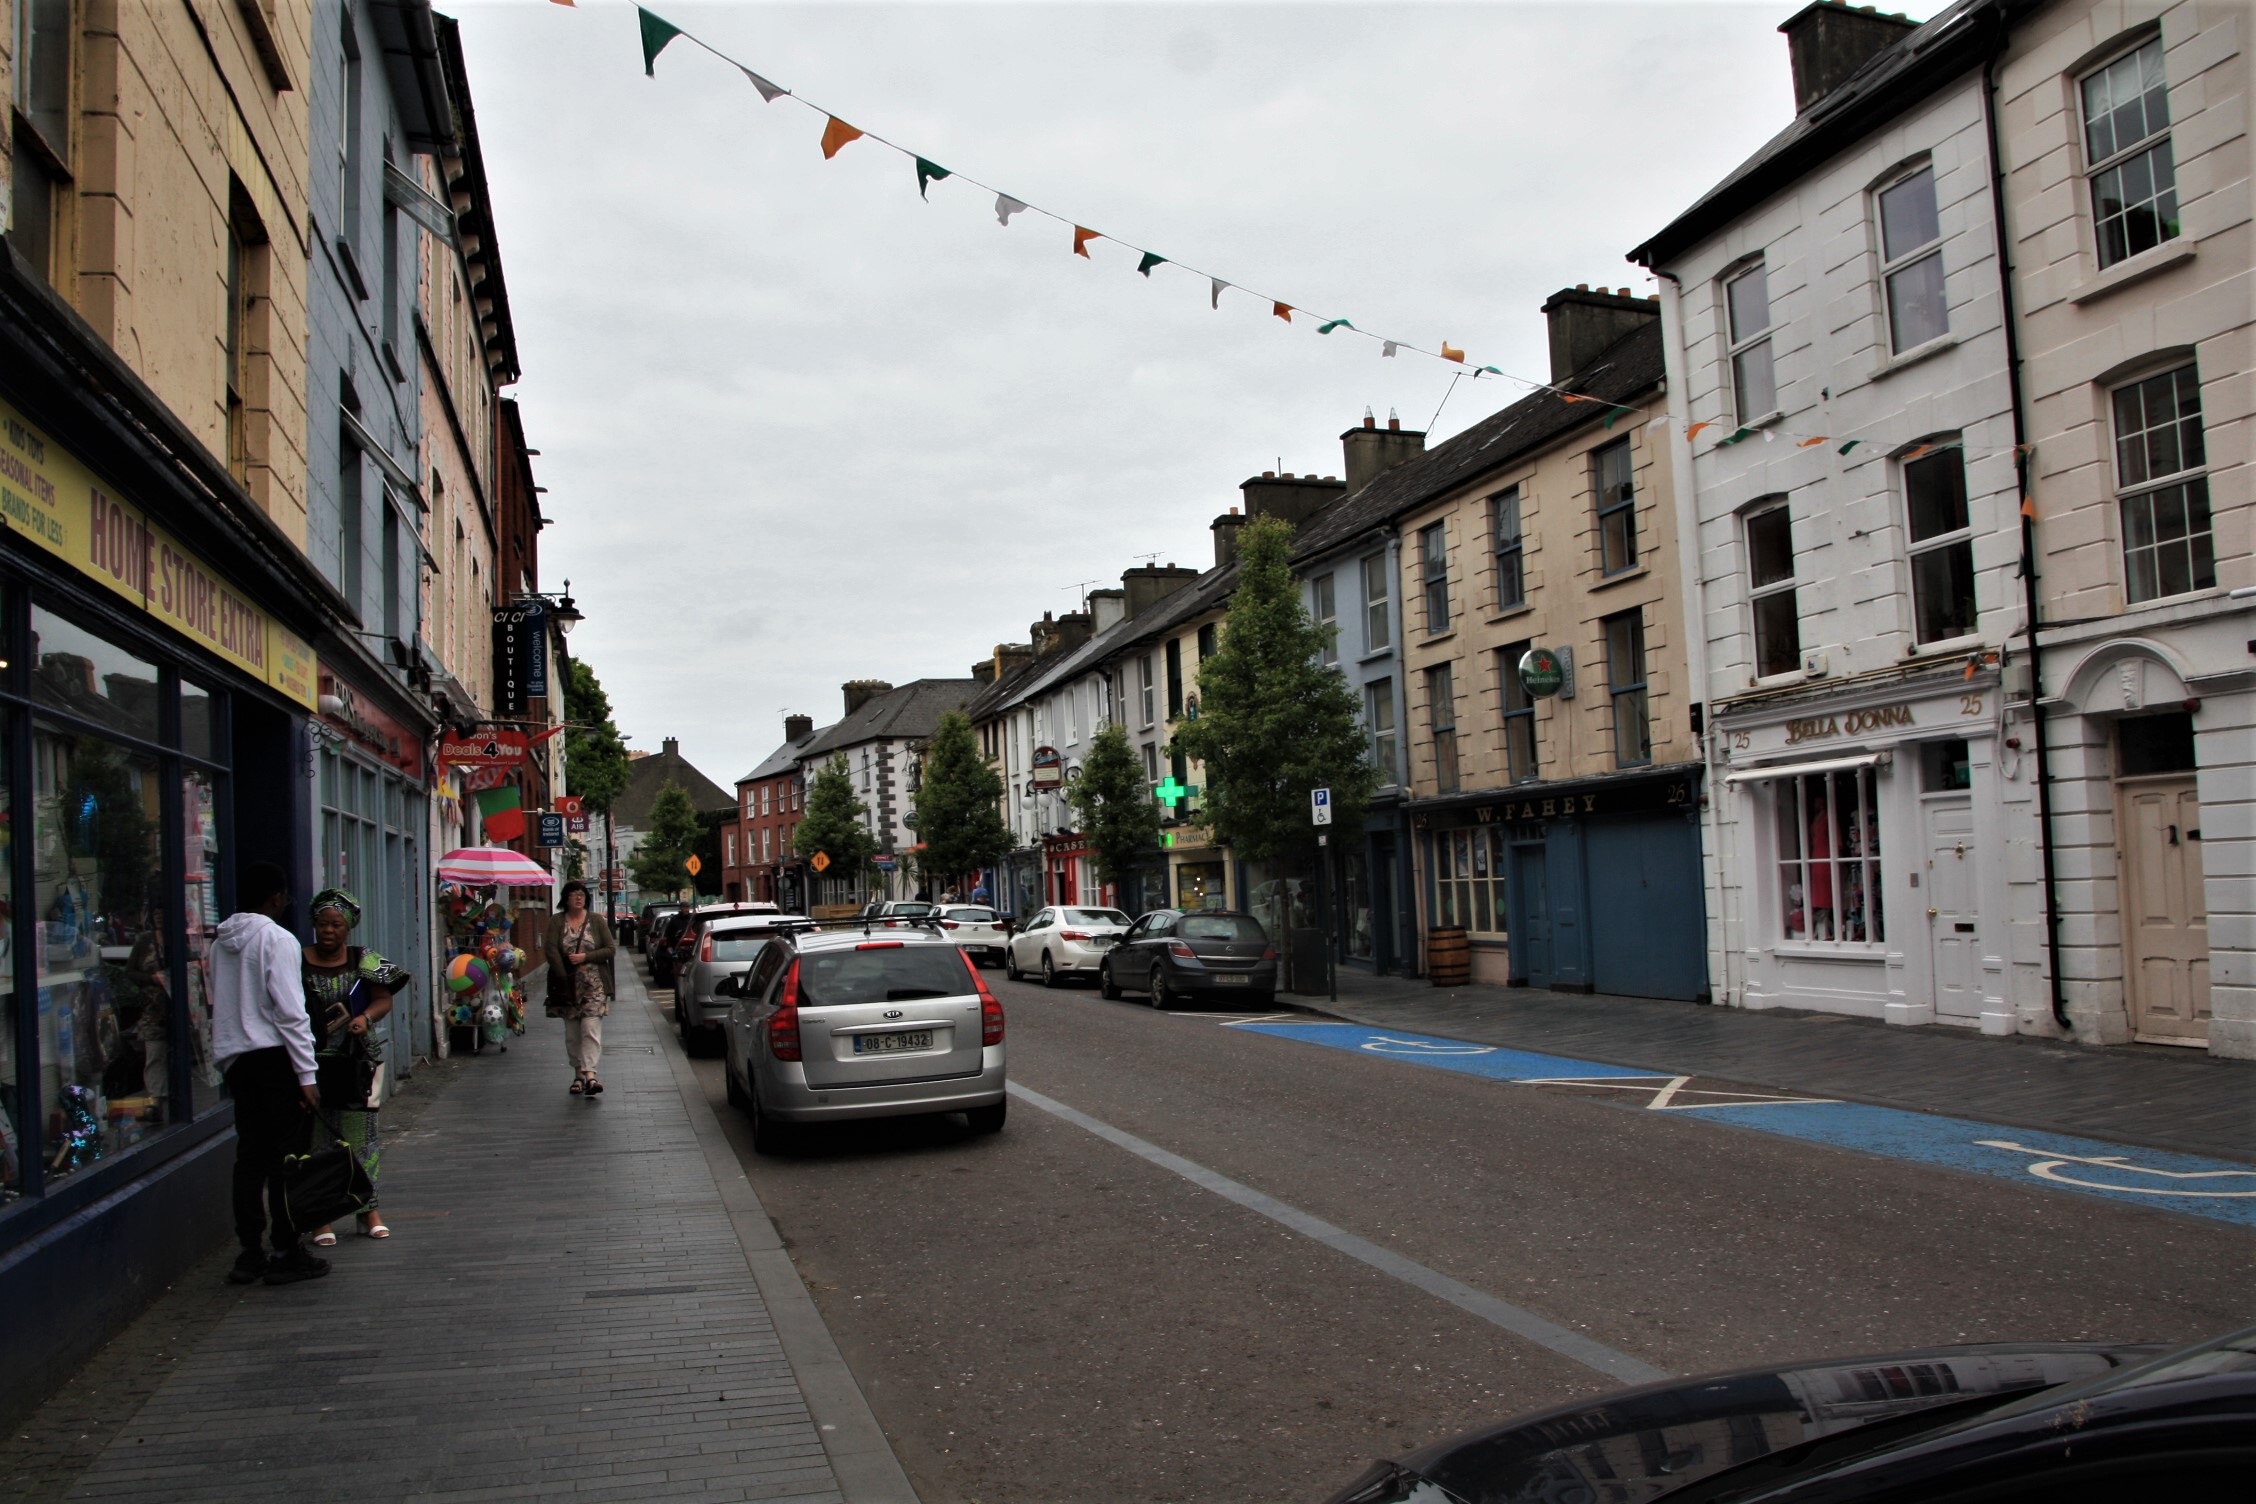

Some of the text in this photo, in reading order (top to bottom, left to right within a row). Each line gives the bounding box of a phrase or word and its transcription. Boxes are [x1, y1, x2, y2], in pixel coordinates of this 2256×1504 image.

[9, 417, 44, 465] KIDS TOYS
[35, 472, 55, 508] ITEMS
[2, 485, 62, 546] BRANDS FOR LESS
[90, 486, 263, 670] HOME STORE EXTRA
[494, 612, 526, 623] CI CI
[532, 630, 544, 678] welcome
[507, 624, 515, 710] BOUTIQUE
[1526, 676, 1561, 684] Heineken
[1960, 694, 1984, 716] 25
[1785, 705, 1915, 746] BELLA DONNA
[443, 741, 523, 759] Deals 4 You
[1734, 733, 1750, 749] 25
[1317, 792, 1324, 805] P
[1668, 784, 1686, 803] 26
[1505, 795, 1596, 820] FAHEY
[1416, 813, 1428, 828] 26
[866, 1034, 928, 1051] 08-C-19432
